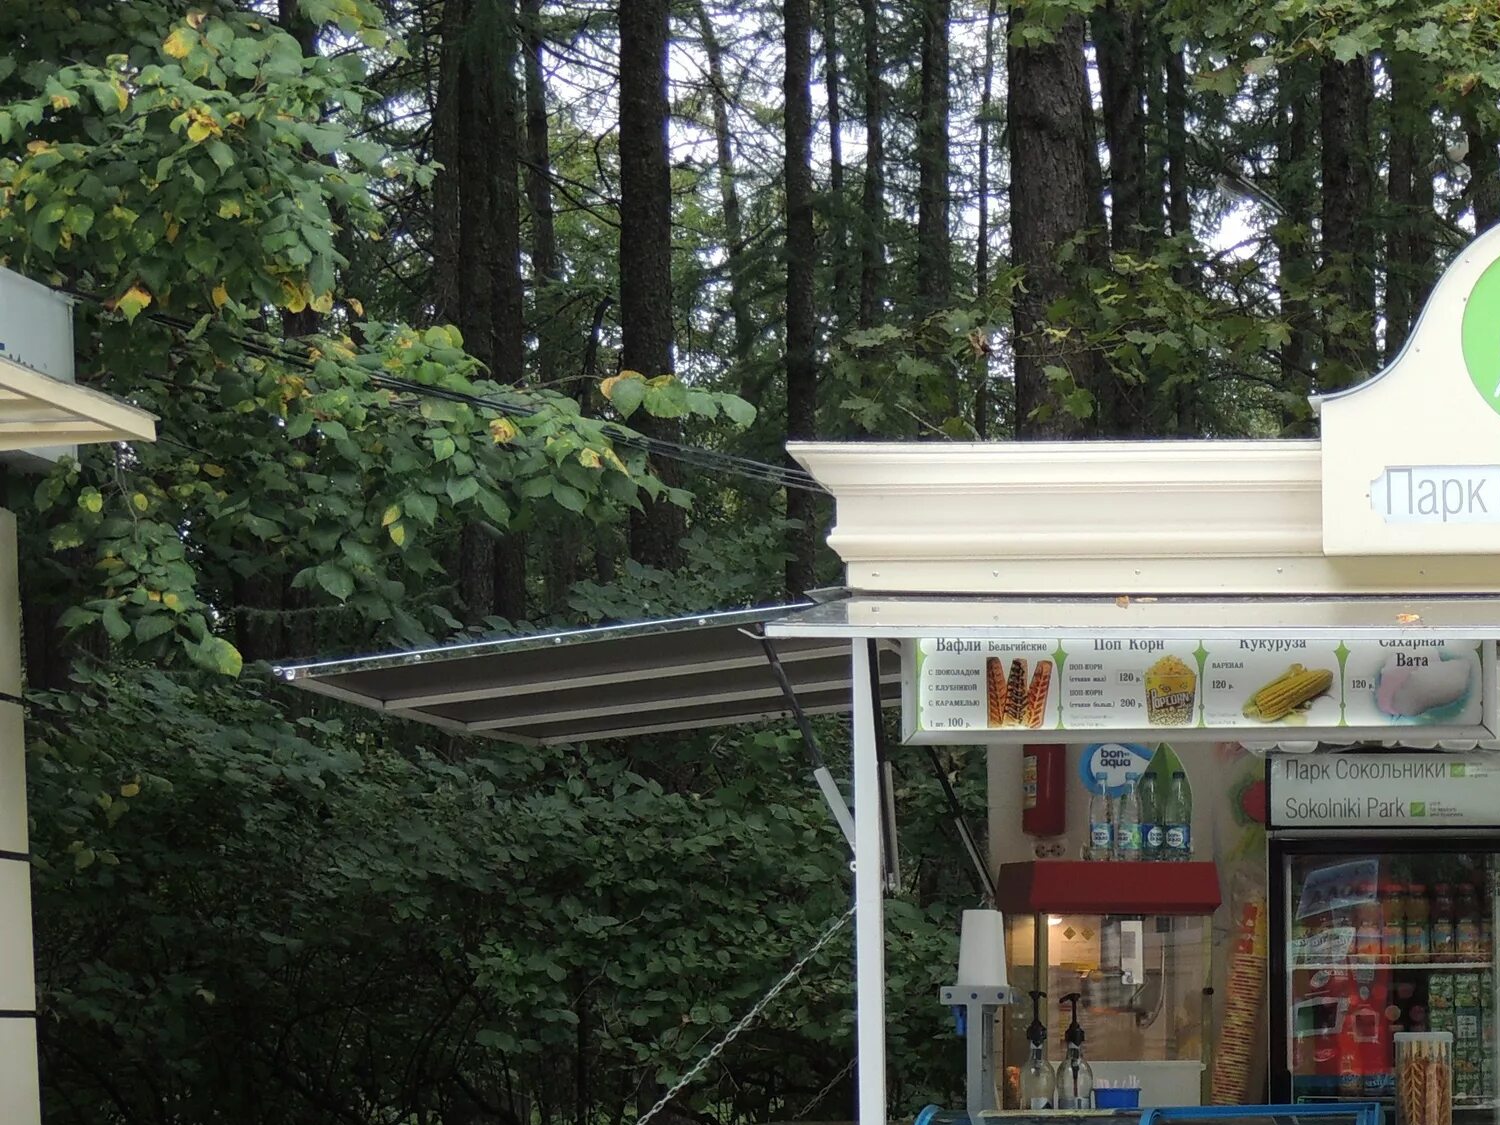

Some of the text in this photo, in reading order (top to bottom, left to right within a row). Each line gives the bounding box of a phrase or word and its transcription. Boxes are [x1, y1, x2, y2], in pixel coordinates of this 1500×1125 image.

[1385, 467, 1488, 522] Парк
[936, 638, 1048, 655] Вафли Бельгийские
[1094, 638, 1165, 652] Поп Корн
[1240, 640, 1307, 652] Кукуруза
[1396, 653, 1429, 667] Вата
[1119, 673, 1134, 682] 120
[1212, 680, 1227, 689] 120
[1352, 680, 1367, 689] 120
[1120, 699, 1136, 707] 200
[948, 718, 964, 727] 100
[1100, 759, 1131, 769] aqua
[1285, 759, 1330, 786] Парк
[1335, 758, 1446, 780] Сокольники
[1285, 797, 1361, 819] Sokolniki
[1367, 797, 1405, 818] Park
